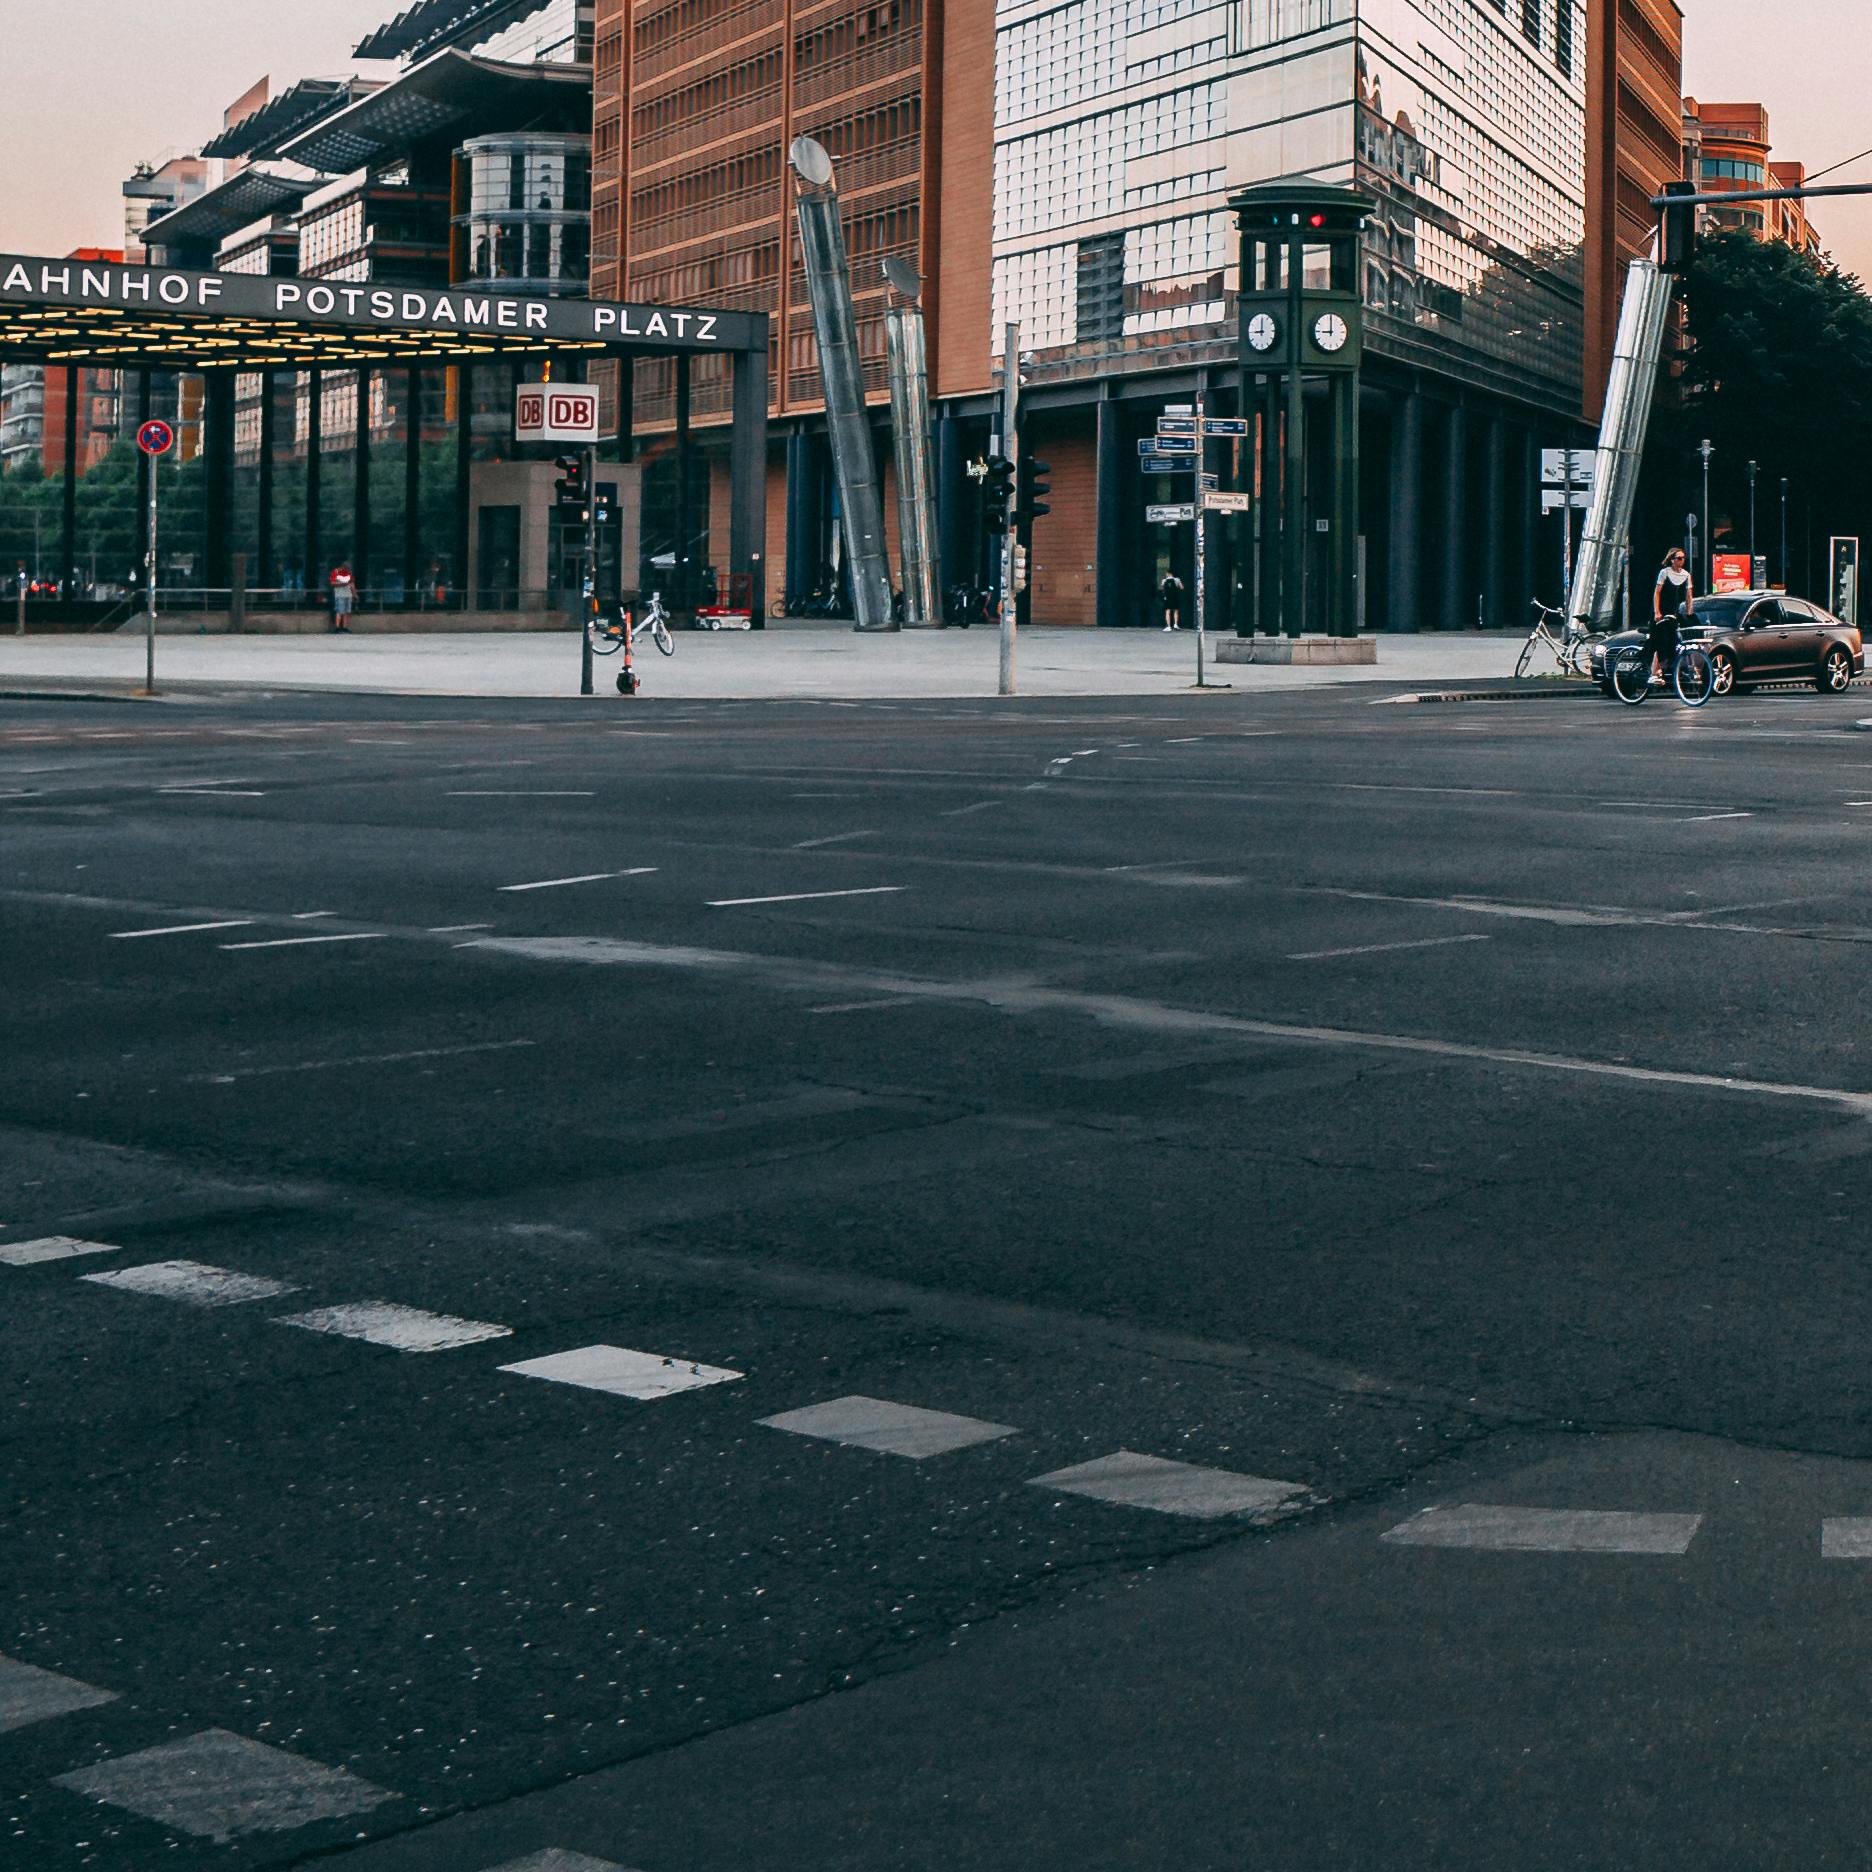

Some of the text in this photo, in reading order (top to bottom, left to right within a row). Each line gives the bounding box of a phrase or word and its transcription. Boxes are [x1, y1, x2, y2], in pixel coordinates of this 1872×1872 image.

[275, 283, 549, 329] POTSDAMER
[593, 307, 718, 340] PLATZ
[521, 399, 541, 424] DB
[554, 399, 590, 425] DB
